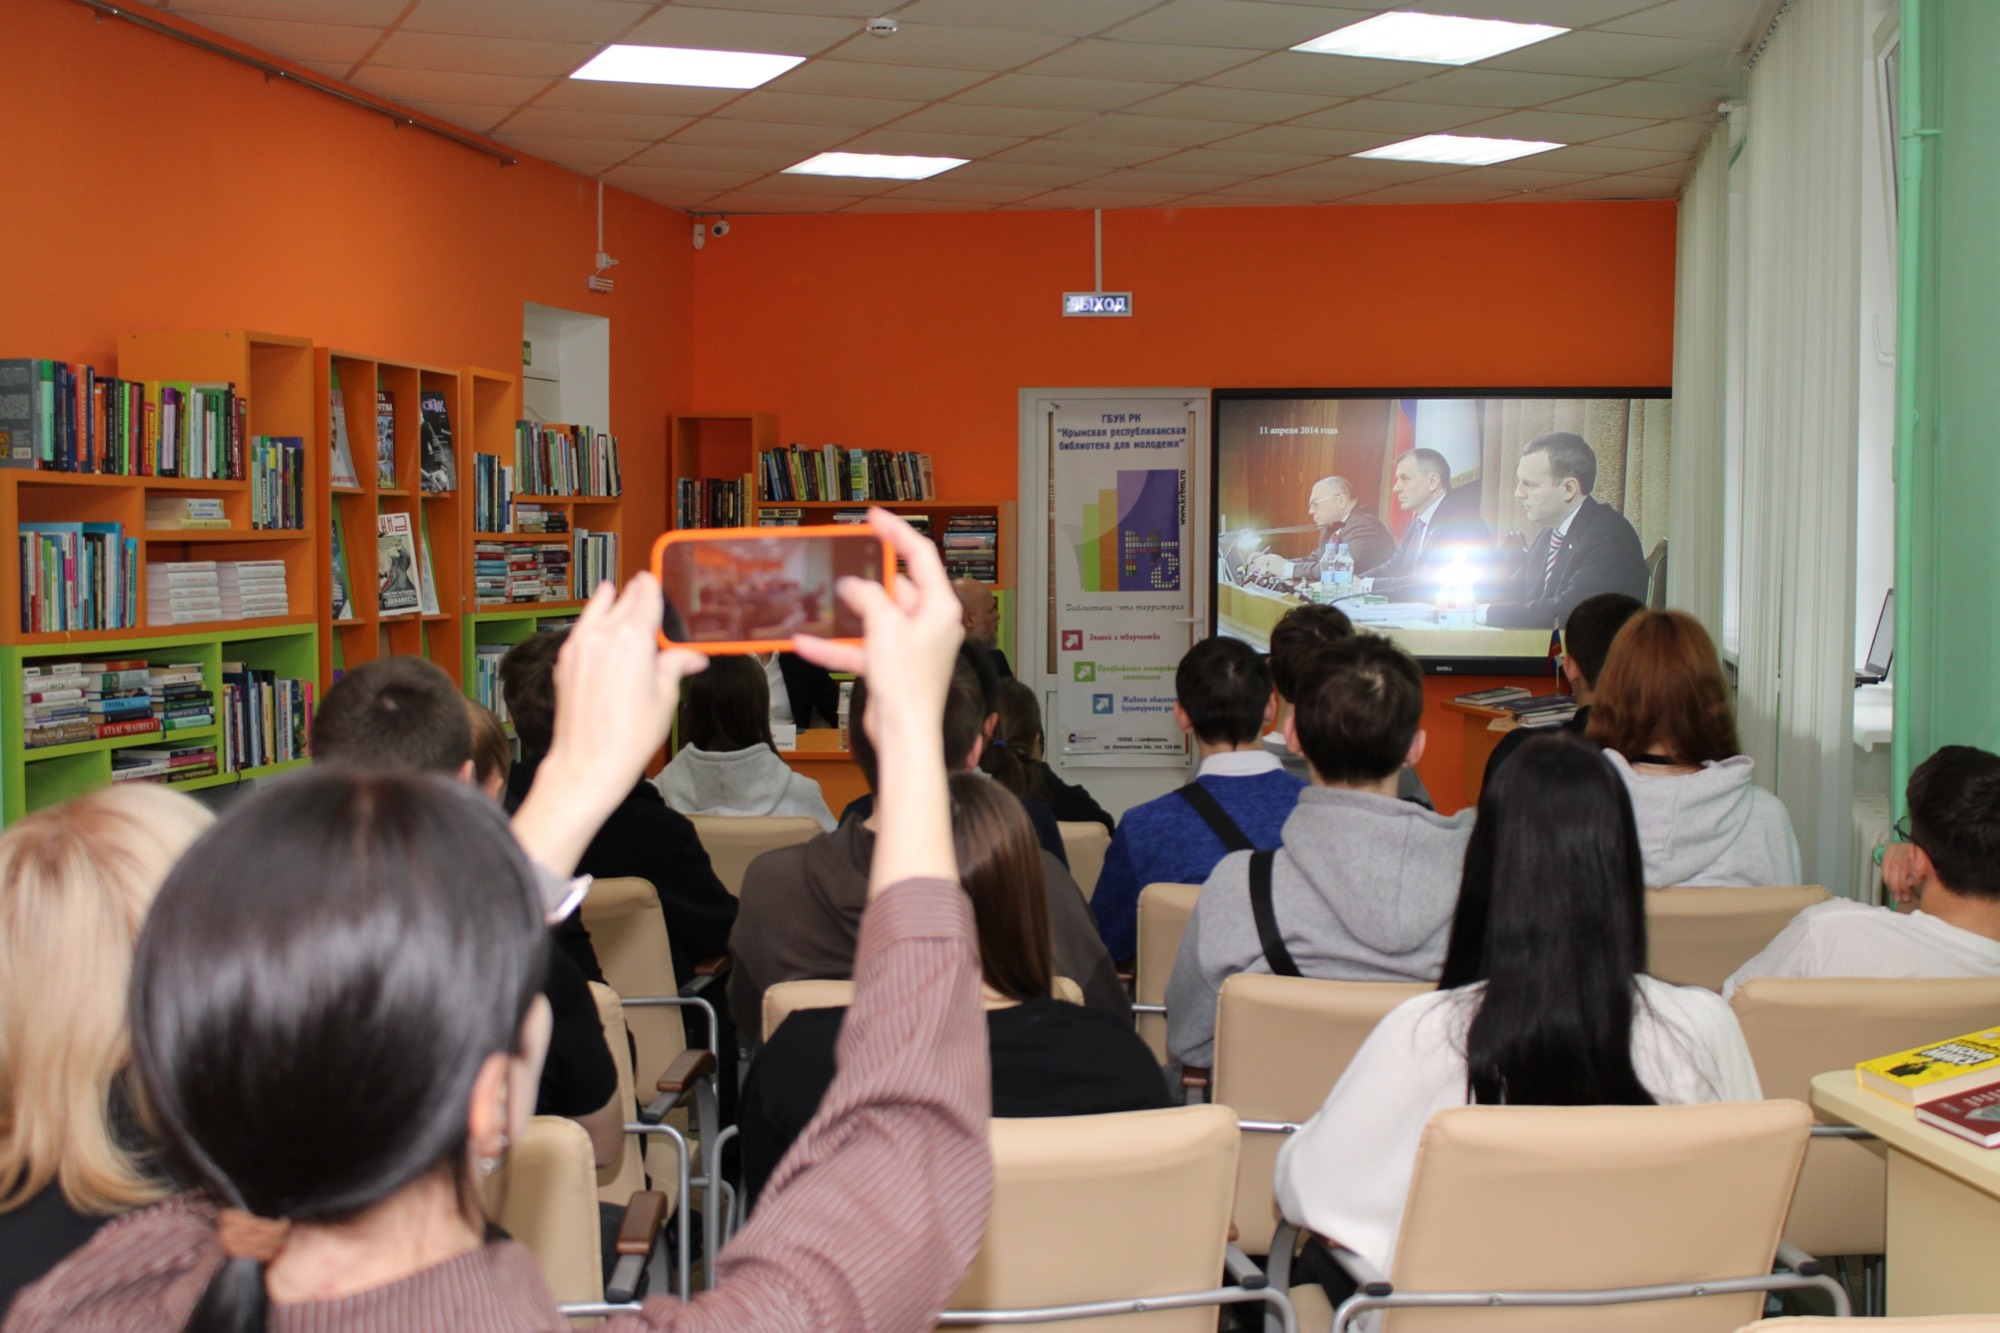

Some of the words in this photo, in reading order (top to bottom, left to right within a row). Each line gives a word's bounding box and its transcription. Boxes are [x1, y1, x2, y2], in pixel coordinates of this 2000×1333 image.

[1101, 414, 1126, 423] ГБУК
[1128, 413, 1141, 423] РК
[1110, 426, 1187, 438] республиканская
[1259, 426, 1268, 434] 11
[1270, 427, 1298, 436] апреля
[1300, 426, 1319, 434] 2014
[1320, 427, 1338, 435] года
[1058, 441, 1111, 451] библиотека
[1113, 441, 1130, 450] для
[1178, 469, 1186, 526] www.krbm.ru
[103, 724, 123, 736] АТЛАС
